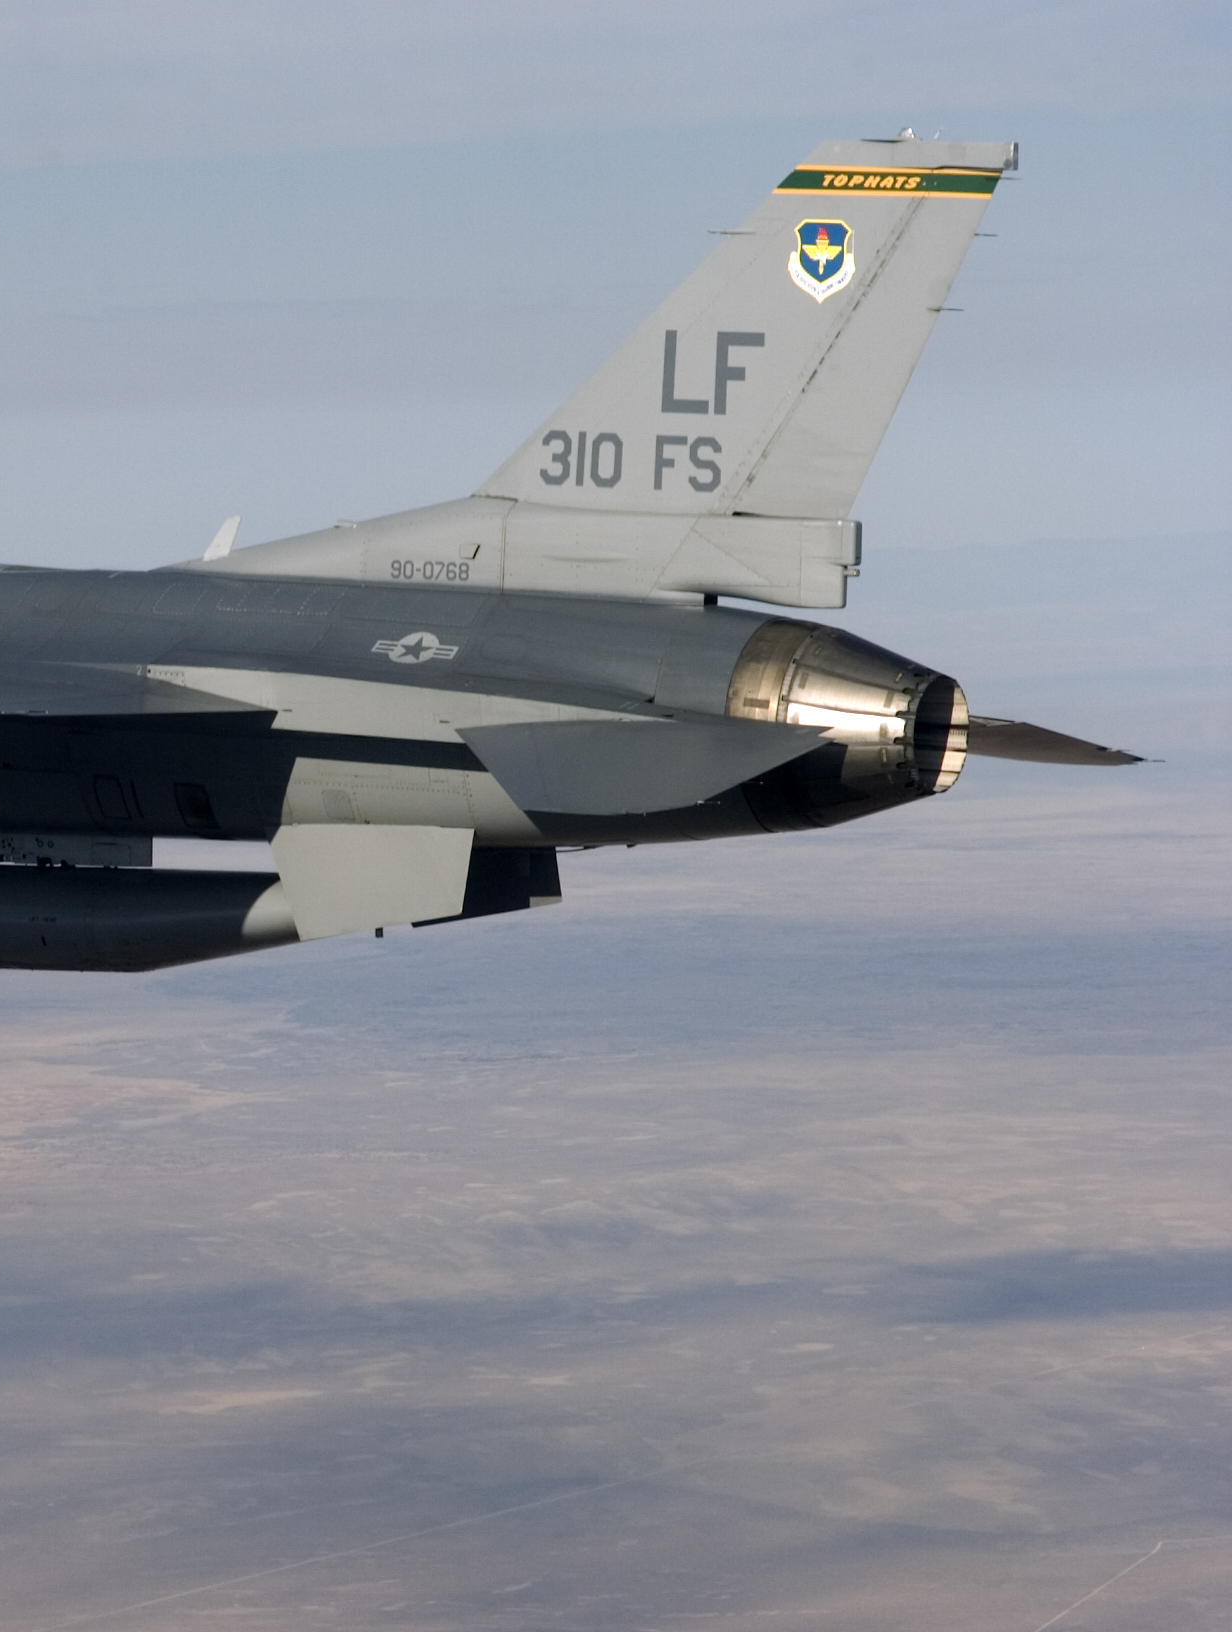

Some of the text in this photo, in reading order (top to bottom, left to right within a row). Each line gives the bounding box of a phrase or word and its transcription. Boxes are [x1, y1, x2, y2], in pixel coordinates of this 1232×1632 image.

[822, 173, 921, 190] TOPHATS
[661, 329, 765, 415] LF
[539, 430, 722, 493] 310 FS
[390, 560, 470, 581] 90-0768
